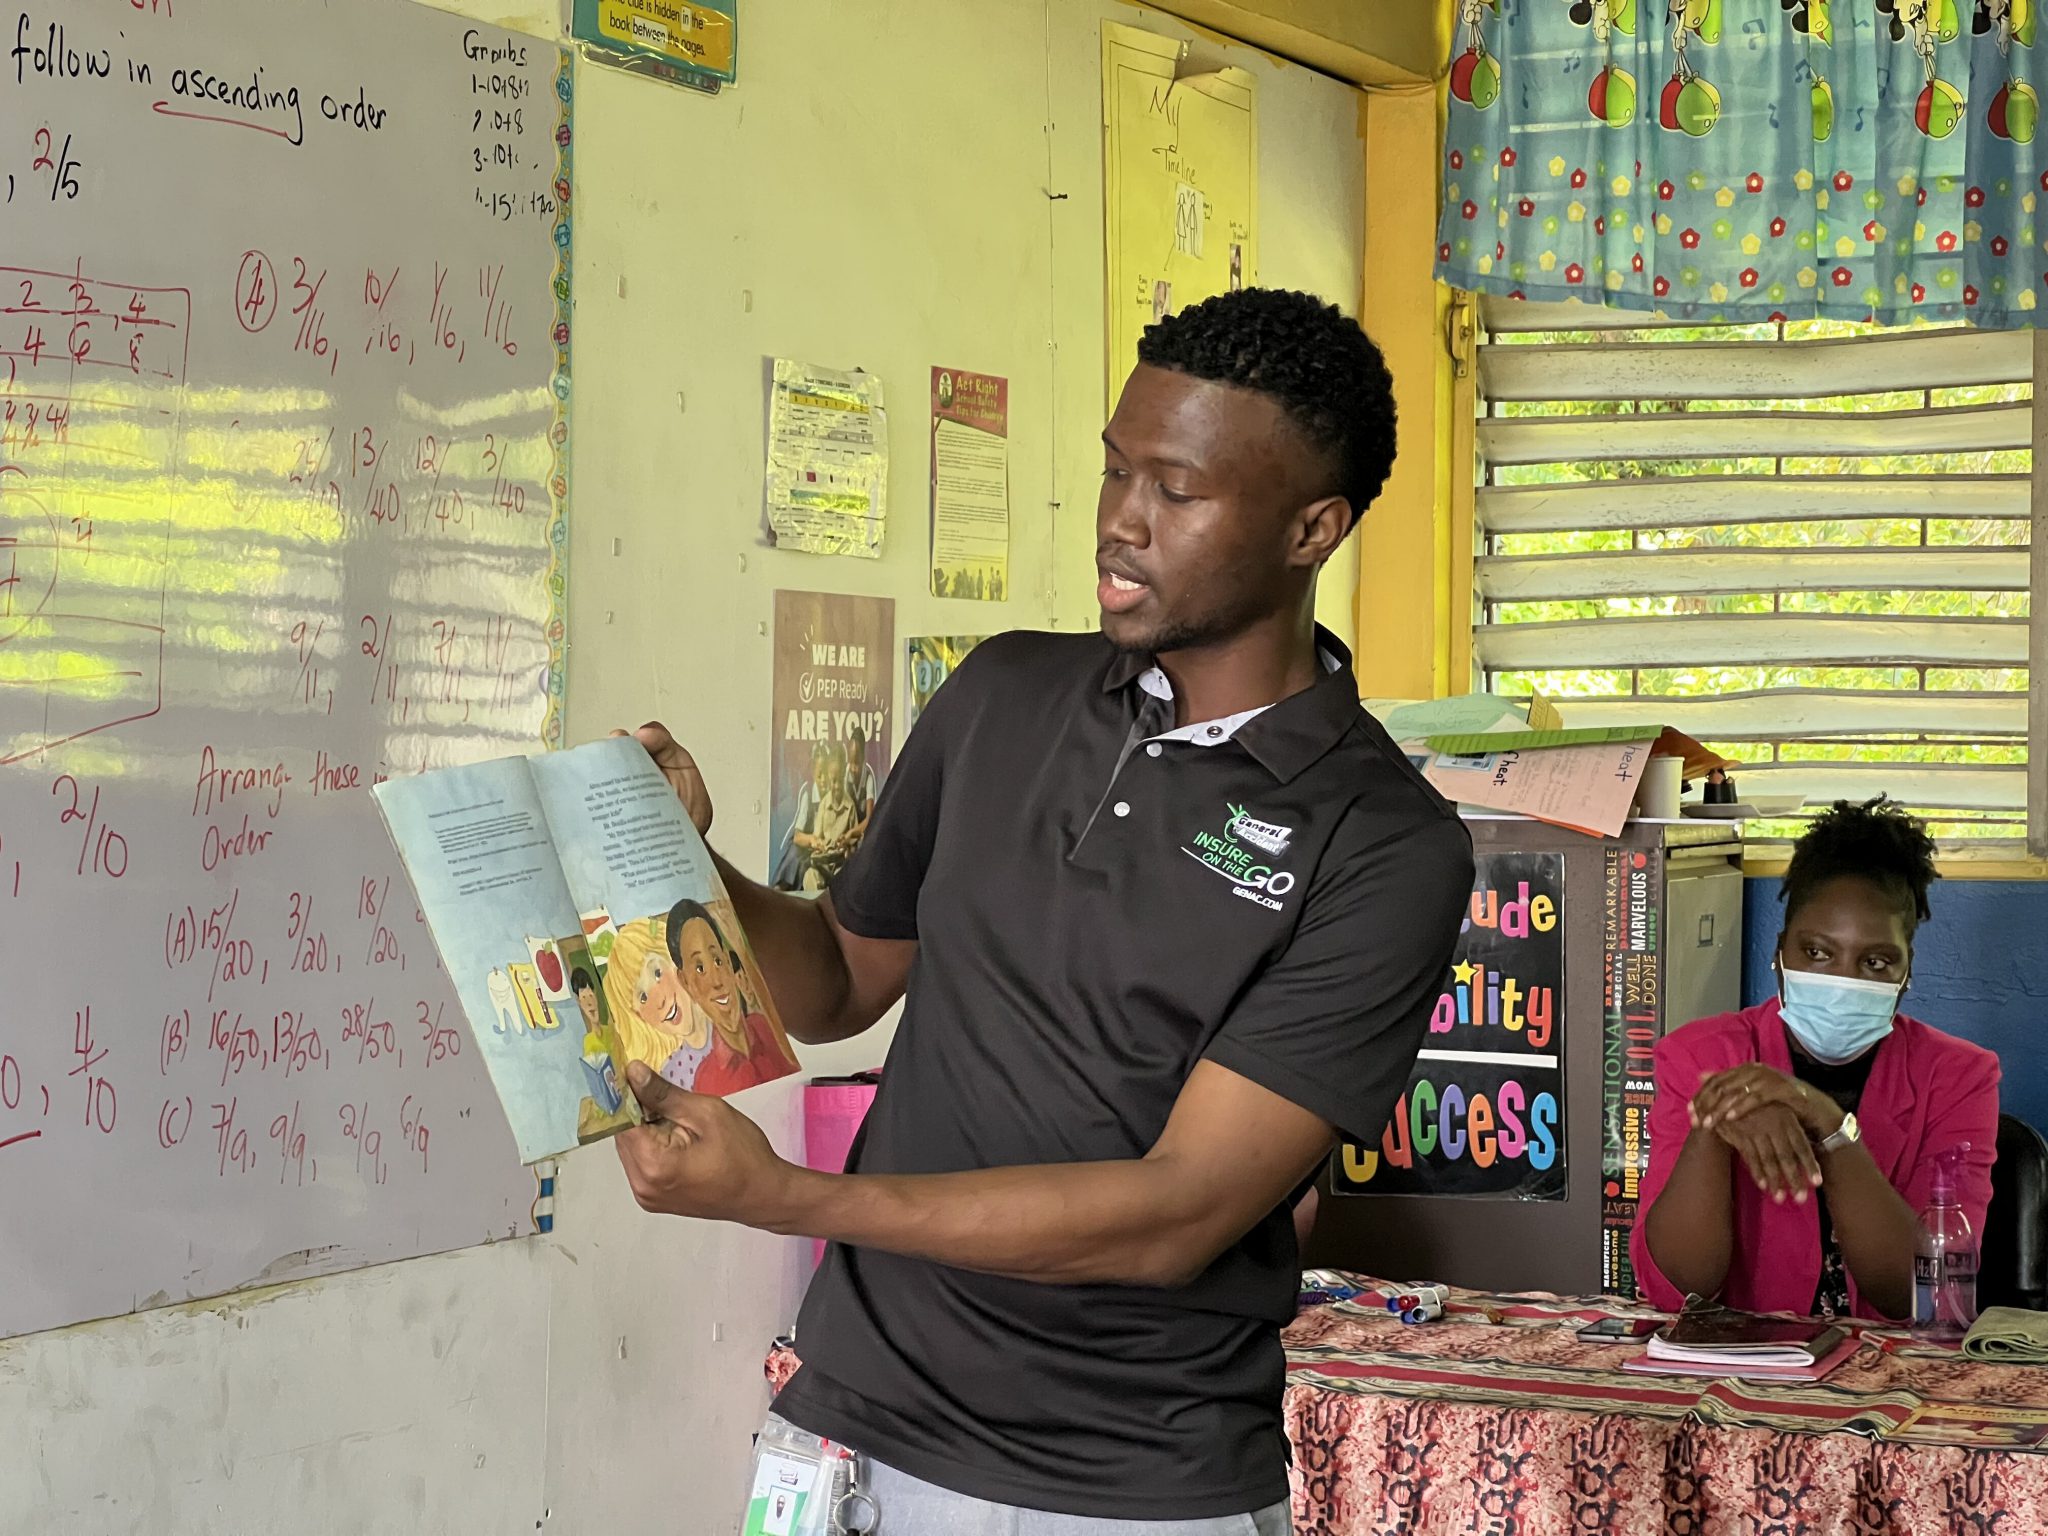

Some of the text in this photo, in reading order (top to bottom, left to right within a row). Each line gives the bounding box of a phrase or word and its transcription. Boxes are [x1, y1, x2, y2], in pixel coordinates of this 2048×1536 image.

[609, 10, 631, 32] book
[633, 19, 666, 42] between
[667, 29, 679, 47] the
[654, 3, 680, 21] hidden
[682, 9, 689, 25] in
[692, 13, 704, 29] the
[12, 13, 387, 146] follow in ascending order
[956, 375, 999, 397] Act Right
[812, 644, 865, 668] WE ARE
[817, 678, 868, 703] PEP Ready
[785, 709, 884, 742] ARE YOU?
[308, 750, 362, 797] these
[202, 813, 273, 872] Order
[1193, 831, 1254, 868] INSURE
[1238, 817, 1284, 838] General
[1202, 852, 1295, 895] ON THE GO
[1232, 886, 1283, 911] GENAC.COM
[1605, 850, 1617, 950] REMARKABLE
[1631, 872, 1646, 951] MARVELOUS
[1649, 907, 1657, 951] UNIQUE
[1605, 952, 1613, 1008] BRAVO
[1614, 953, 1622, 1007] SPECIAL
[1625, 953, 1640, 1006] WELL
[1642, 955, 1656, 1006] DONE
[1622, 1107, 1640, 1199] impressive
